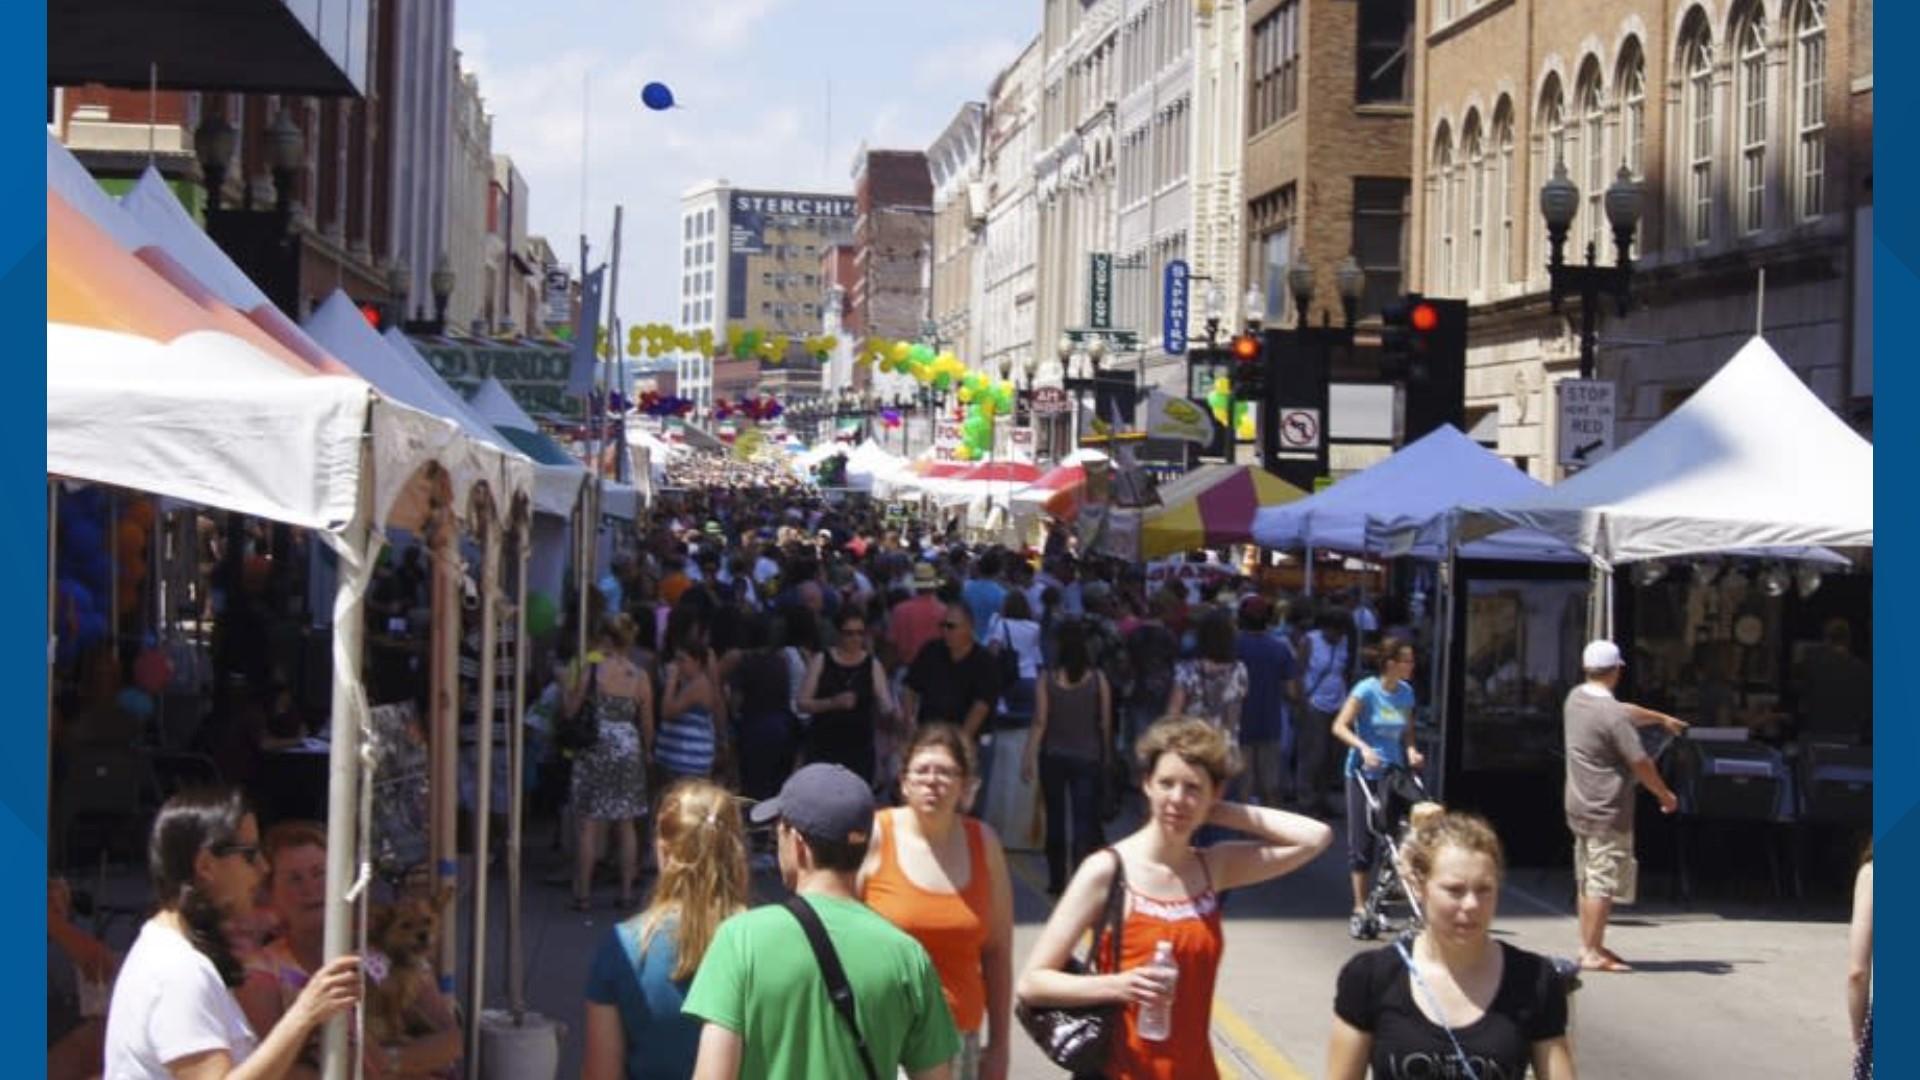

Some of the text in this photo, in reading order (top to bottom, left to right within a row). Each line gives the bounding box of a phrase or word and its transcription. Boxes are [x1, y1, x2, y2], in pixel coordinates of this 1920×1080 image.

[1171, 264, 1185, 351] SAPPHIRE
[473, 350, 567, 381] VENDO
[1567, 386, 1610, 402] STOP
[1571, 418, 1604, 434] RED
